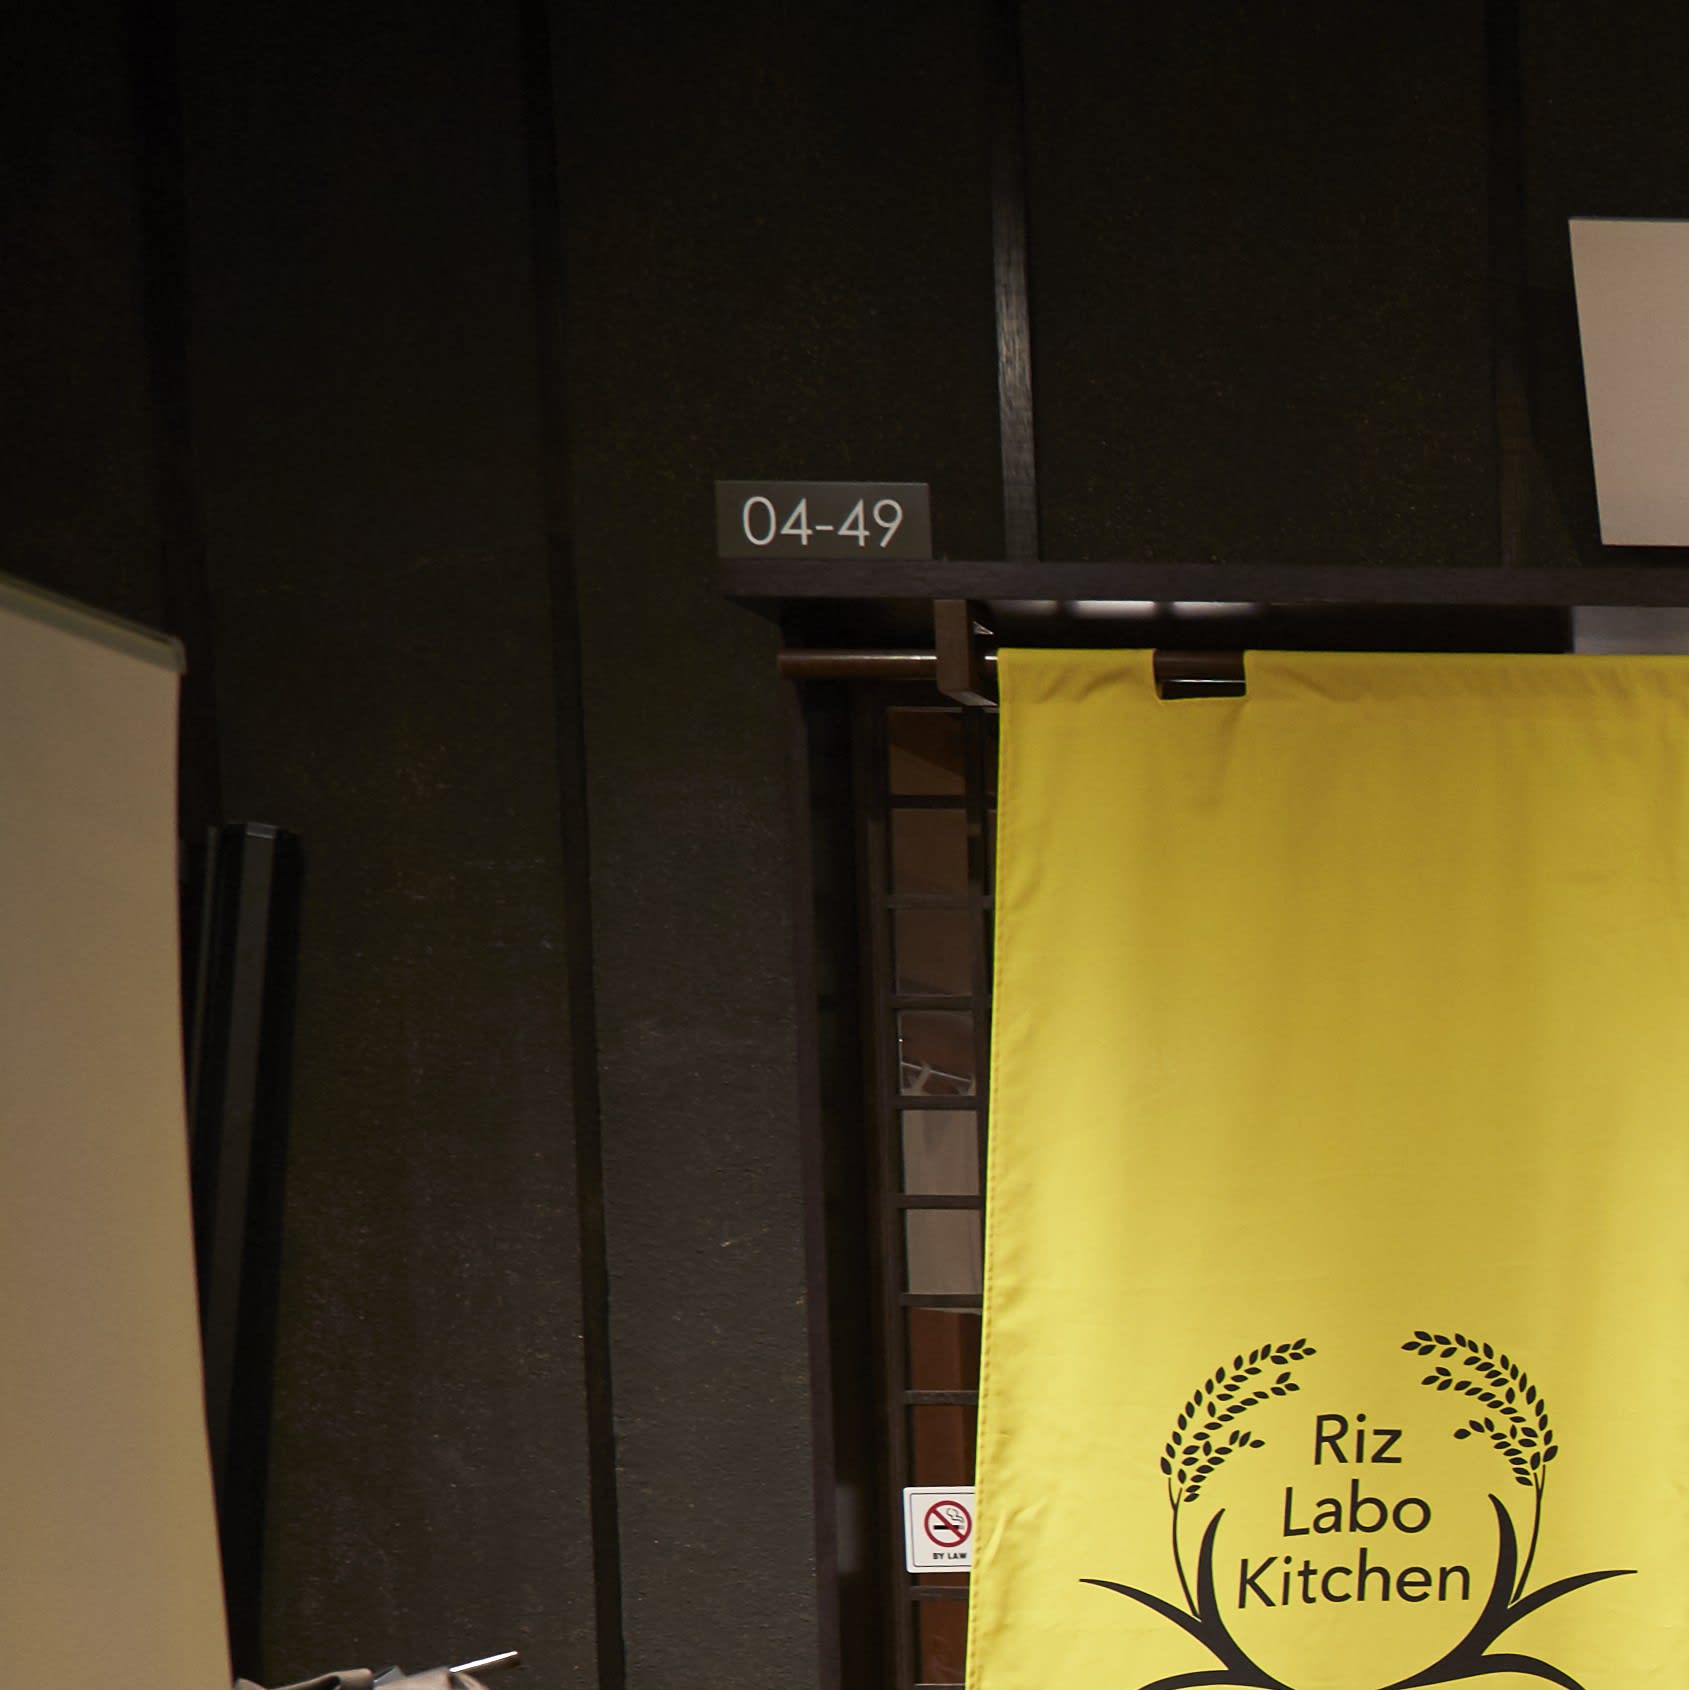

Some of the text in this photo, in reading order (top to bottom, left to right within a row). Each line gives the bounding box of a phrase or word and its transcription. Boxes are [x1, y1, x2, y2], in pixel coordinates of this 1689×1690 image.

[741, 496, 904, 549] 04-49
[1312, 1413, 1403, 1466] Riz
[1281, 1478, 1433, 1537] Labo
[932, 1552, 968, 1560] BY LAW
[1237, 1547, 1472, 1609] Kitchen
